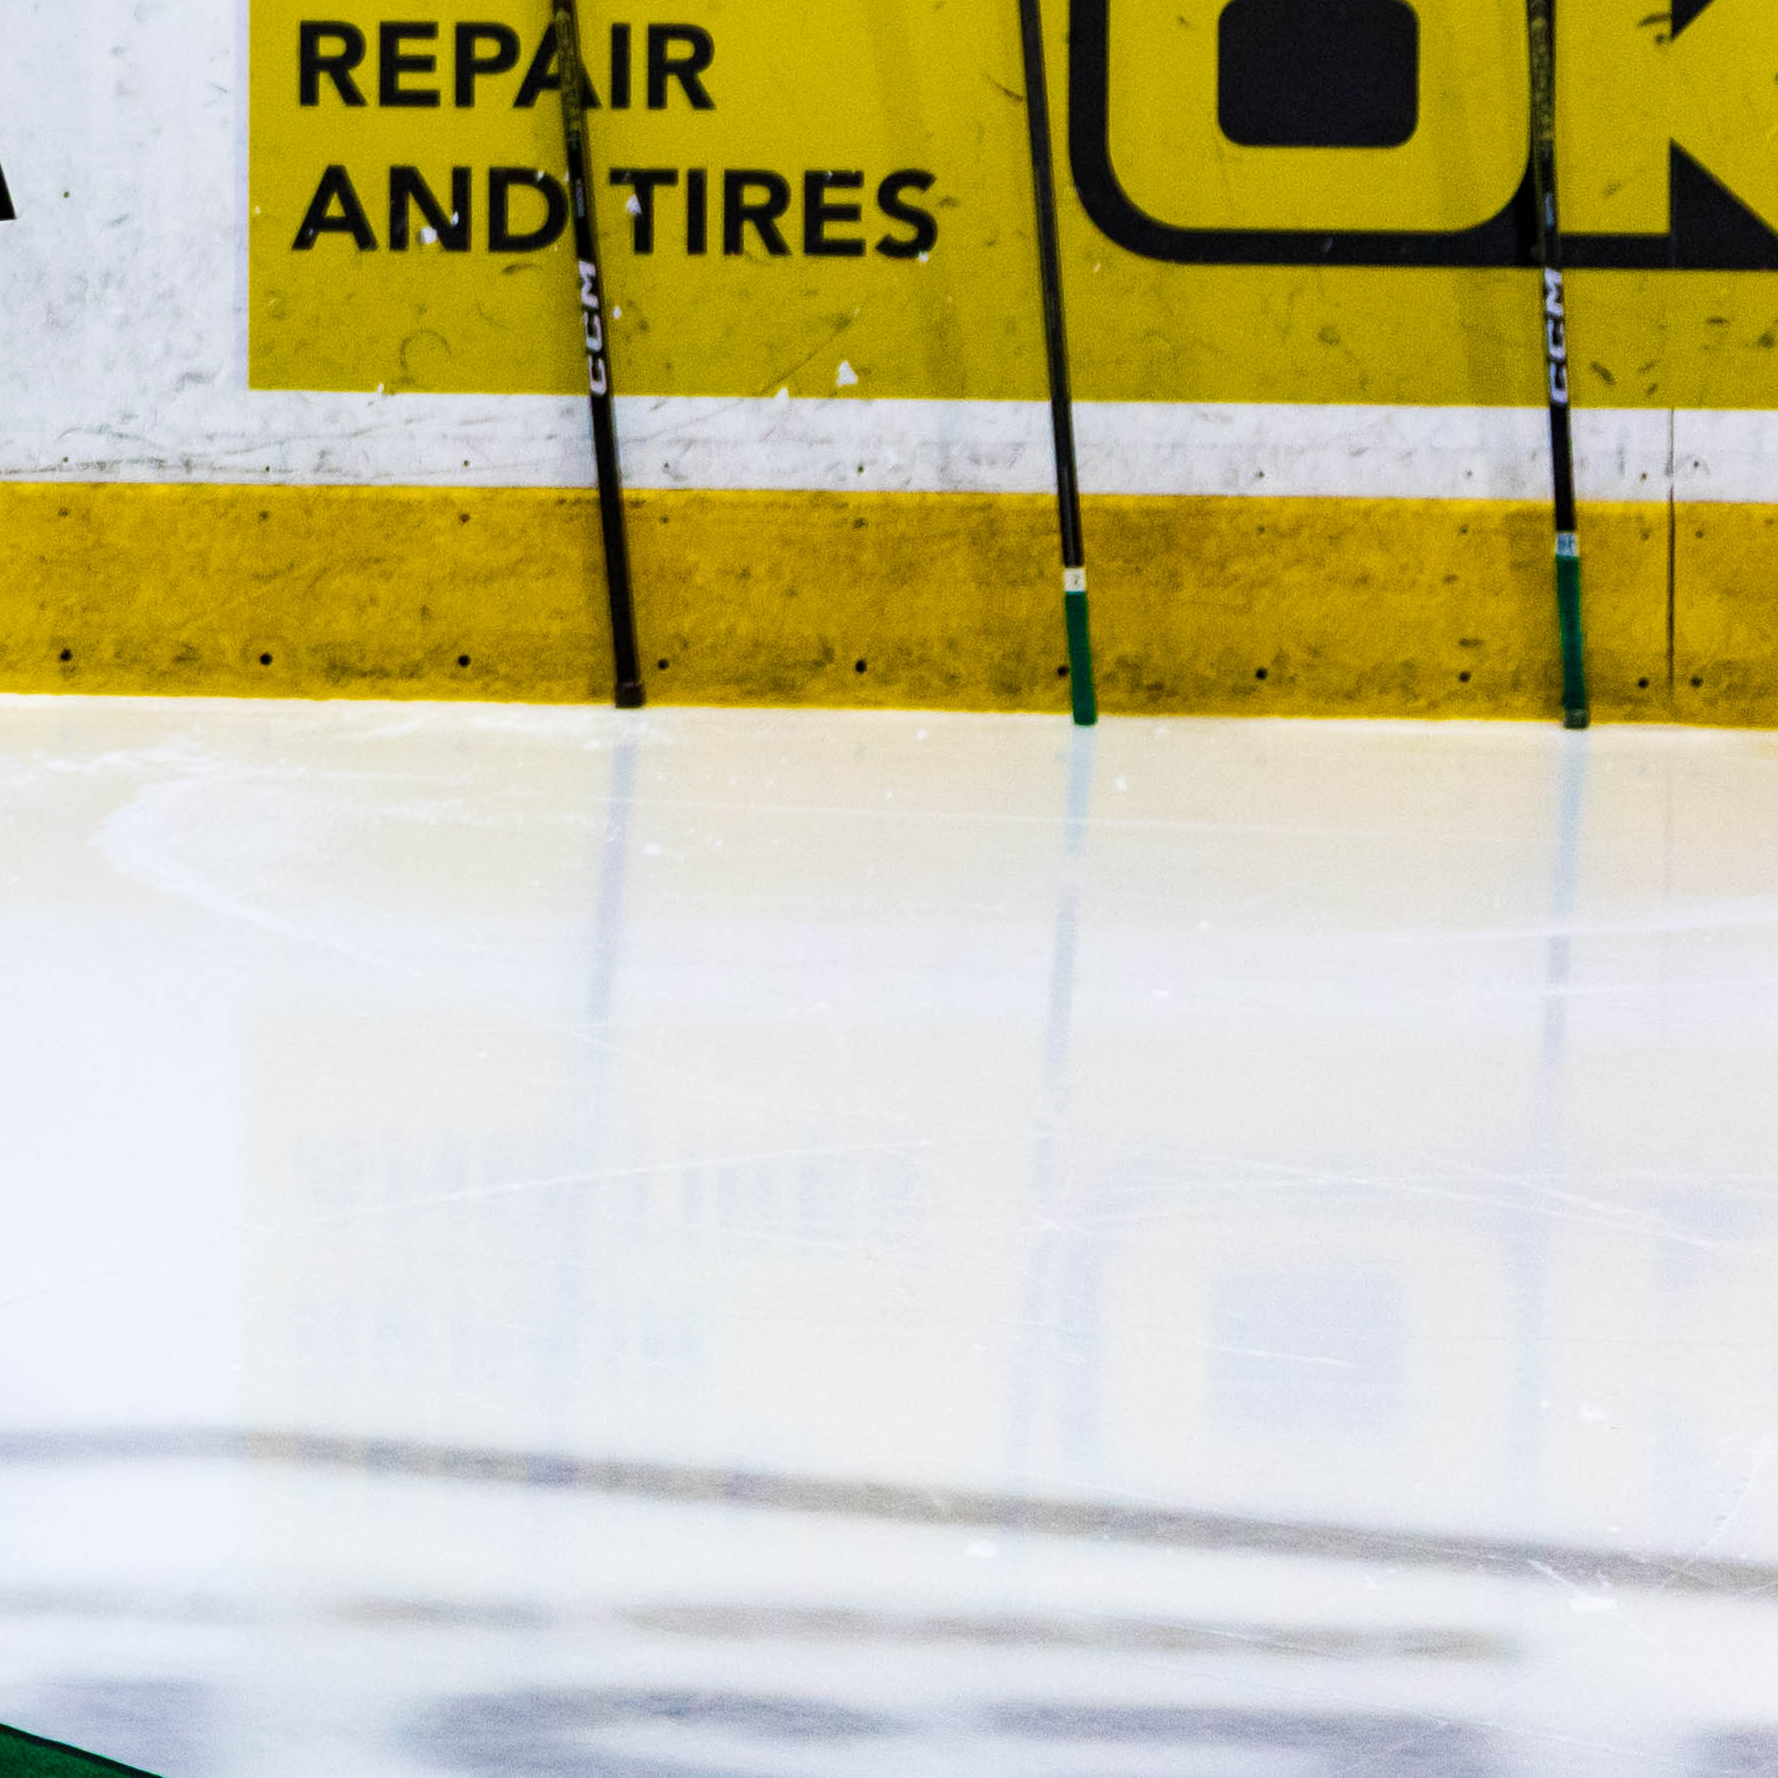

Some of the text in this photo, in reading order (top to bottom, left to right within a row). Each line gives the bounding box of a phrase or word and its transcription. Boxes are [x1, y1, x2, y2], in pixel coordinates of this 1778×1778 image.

[298, 20, 718, 112] REPAIR
[291, 164, 571, 253] AND
[609, 167, 939, 260] TIRES
[577, 258, 608, 398] CCM
[1544, 266, 1569, 406] CCM
